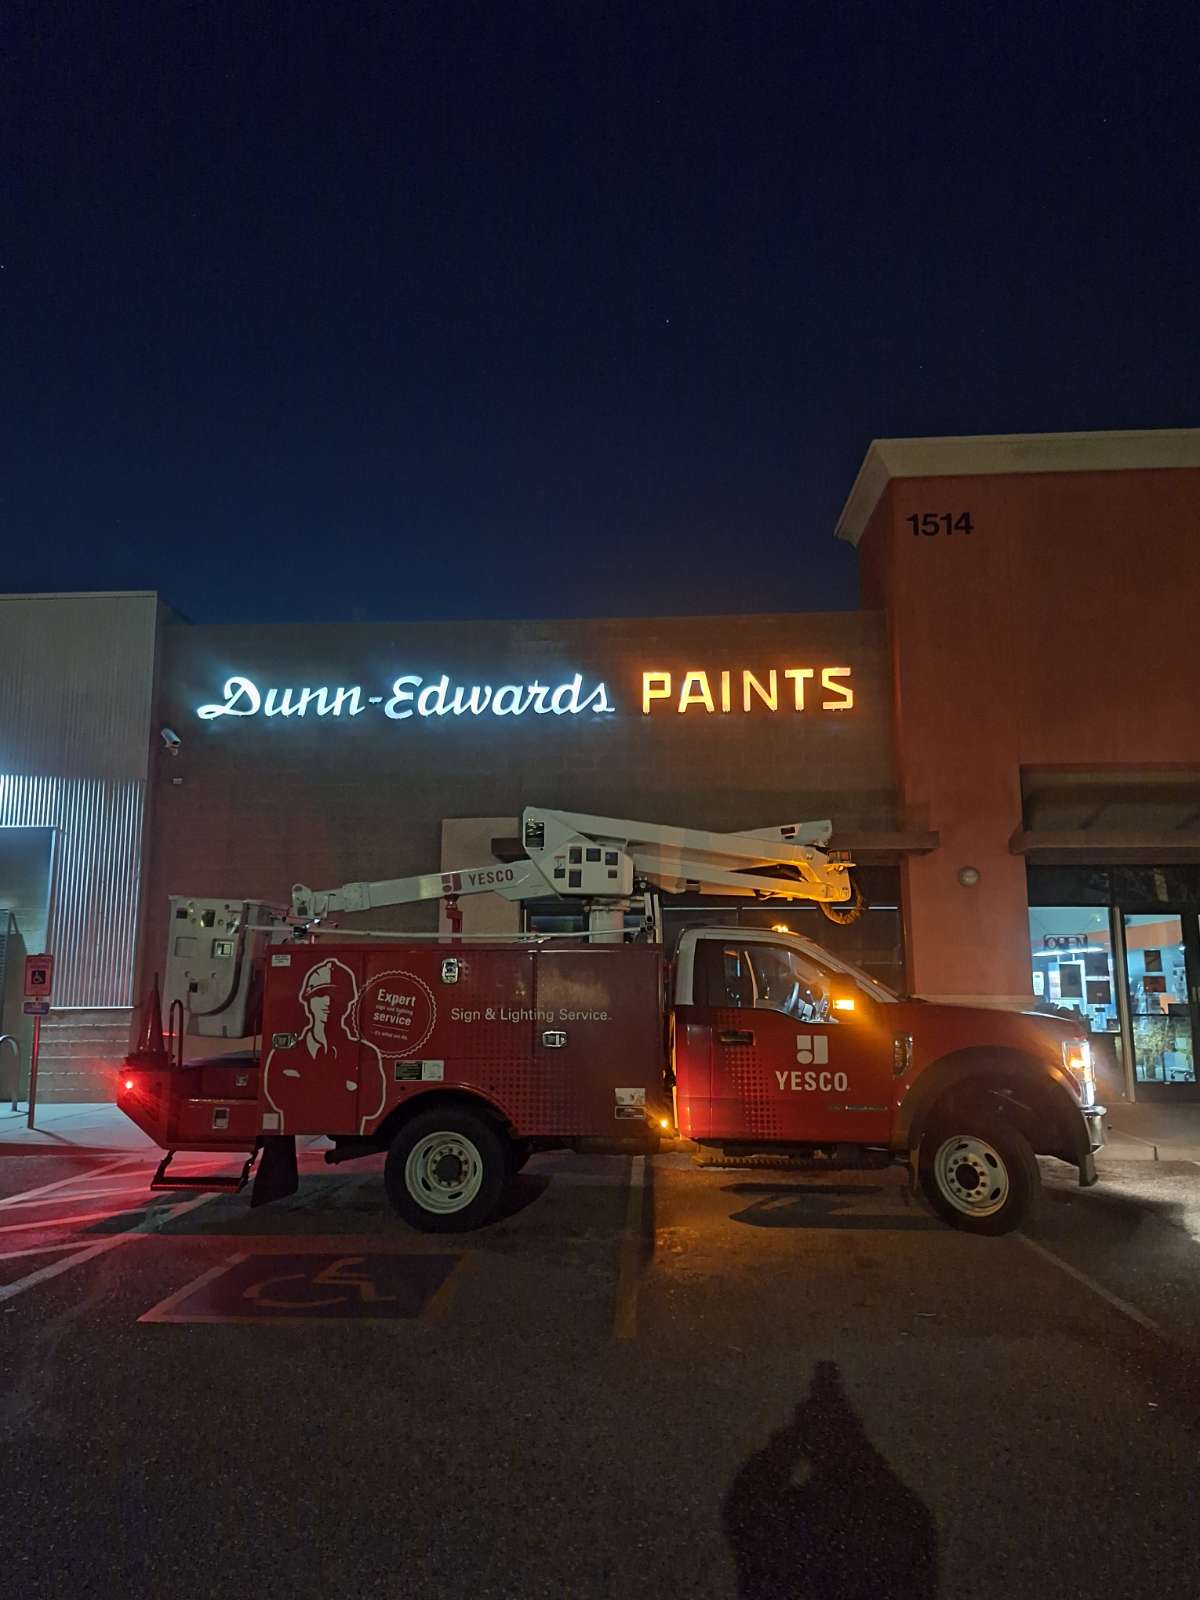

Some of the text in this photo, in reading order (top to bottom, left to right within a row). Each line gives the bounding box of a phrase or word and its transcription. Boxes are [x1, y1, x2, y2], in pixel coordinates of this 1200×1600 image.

[906, 511, 974, 536] 1514
[196, 667, 854, 720] Dunn-Edwards PAINTS
[468, 869, 514, 886] YESCO
[377, 988, 416, 1007] Expert
[373, 1012, 412, 1026] service
[451, 1008, 481, 1023] Sign
[485, 1008, 496, 1020] &
[500, 1008, 555, 1023] Lighting
[775, 1070, 848, 1092] YESCO
